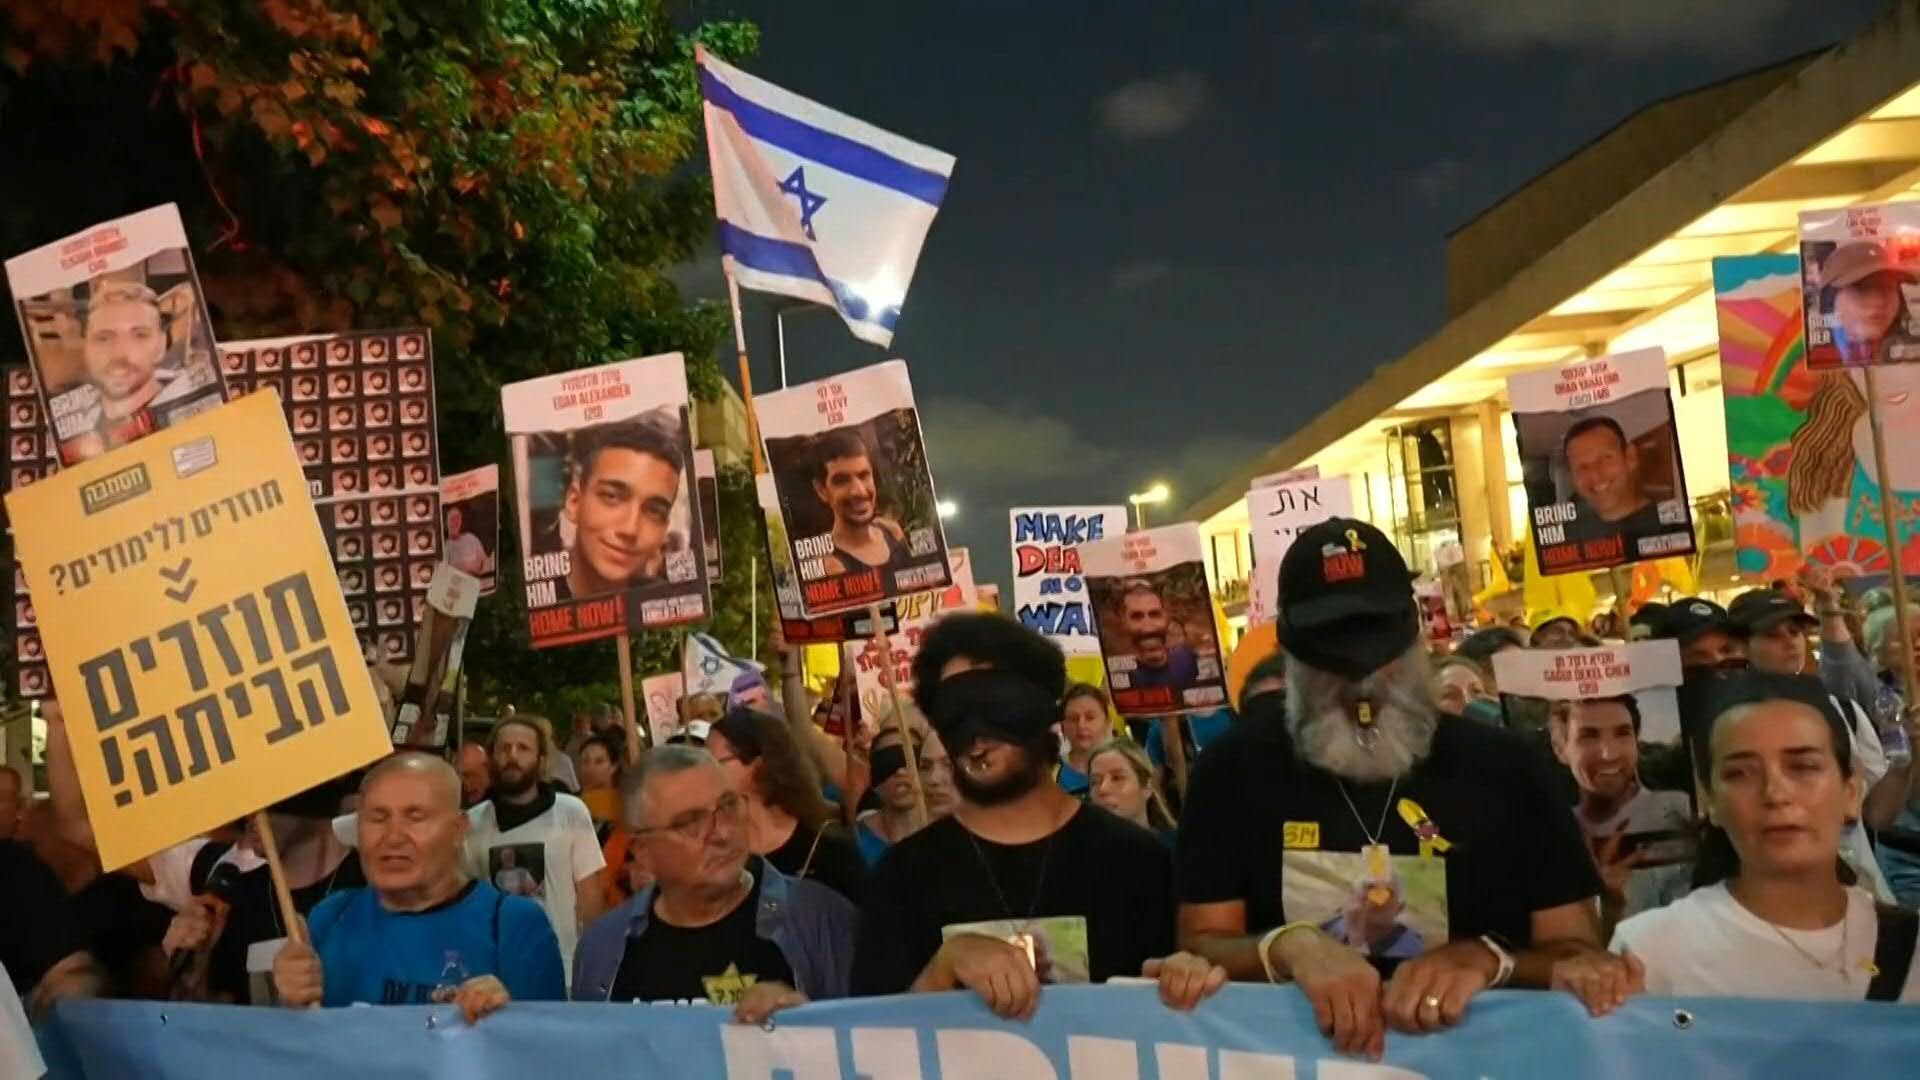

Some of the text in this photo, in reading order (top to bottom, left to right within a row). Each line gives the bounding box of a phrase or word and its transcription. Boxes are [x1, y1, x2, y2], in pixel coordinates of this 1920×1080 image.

[1268, 486, 1321, 516] את
[1534, 501, 1577, 526] BRING
[48, 479, 284, 596] חוזרים ללימודים?
[1015, 512, 1104, 546] MAKE
[1537, 523, 1566, 545] HIM
[794, 533, 835, 559] BRING
[524, 551, 571, 582] BRING
[799, 557, 827, 582] HIM
[1016, 545, 1083, 578] DEA
[526, 580, 557, 608] HIM
[1040, 576, 1082, 595] NO
[78, 571, 329, 732] חוזרים
[100, 645, 351, 808] הביתה!
